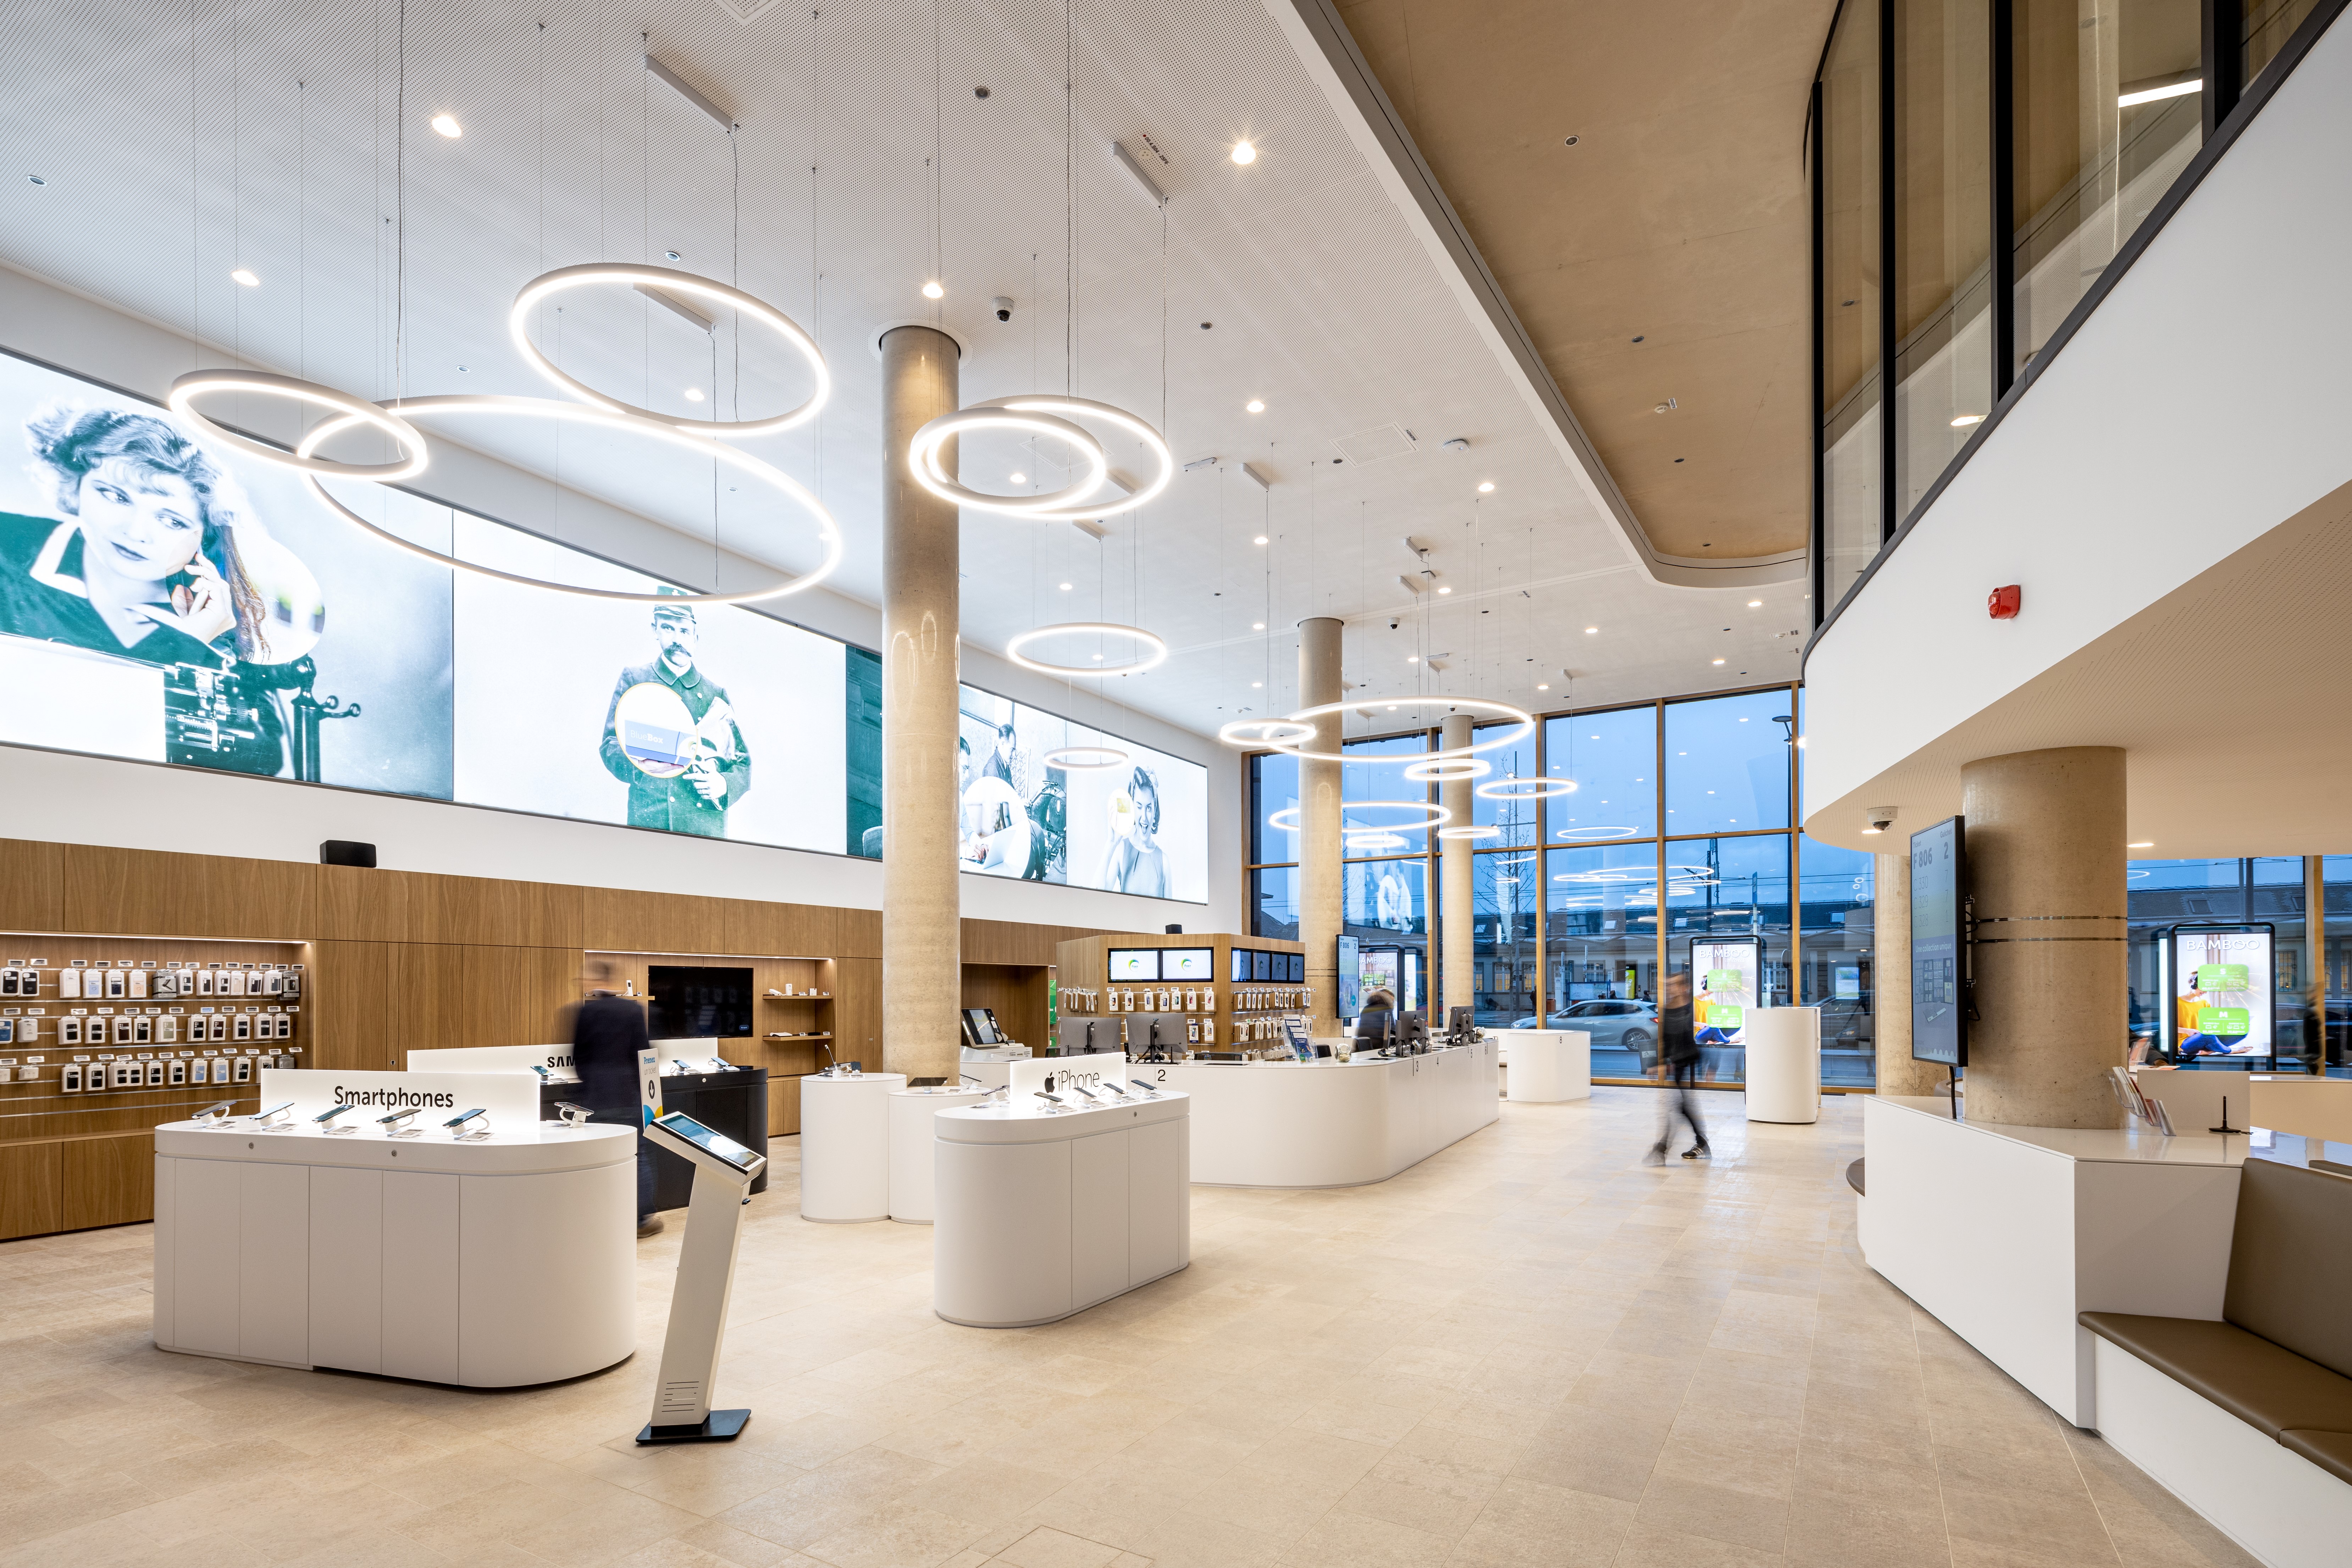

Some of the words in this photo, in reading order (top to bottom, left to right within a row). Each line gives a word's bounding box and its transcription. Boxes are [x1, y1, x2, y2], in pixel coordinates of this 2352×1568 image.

[1145, 137, 1160, 153] 00.4.S04
[1159, 155, 1169, 164] 25F6
[631, 730, 663, 744] BlueBox
[1940, 828, 1952, 838] Guichet
[1913, 840, 1921, 848] Ticket
[1913, 853, 1917, 870] F
[1919, 847, 1932, 868] 806
[1944, 841, 1949, 860] 2
[1913, 879, 1917, 891] C
[1919, 875, 1928, 890] 330
[1944, 869, 1948, 882] 7
[1914, 897, 1917, 909] C
[1919, 894, 1928, 908] 329
[1945, 890, 1948, 903] 7
[1914, 916, 1917, 928] C
[1919, 913, 1928, 927] 328
[1946, 910, 1948, 922] 1
[1922, 943, 1939, 952] collection
[1939, 942, 1952, 950] unique
[2186, 939, 2260, 951] BAMBOO
[1699, 949, 1750, 958] BAMBOO
[1470, 1049, 1473, 1058] 5
[1485, 1046, 1487, 1055] 6
[1416, 1061, 1418, 1072] 3
[1436, 1057, 1439, 1066] 4
[1058, 1069, 1100, 1092] iPhone
[1158, 1069, 1166, 1081] 2
[334, 1086, 453, 1110] Smartphones
